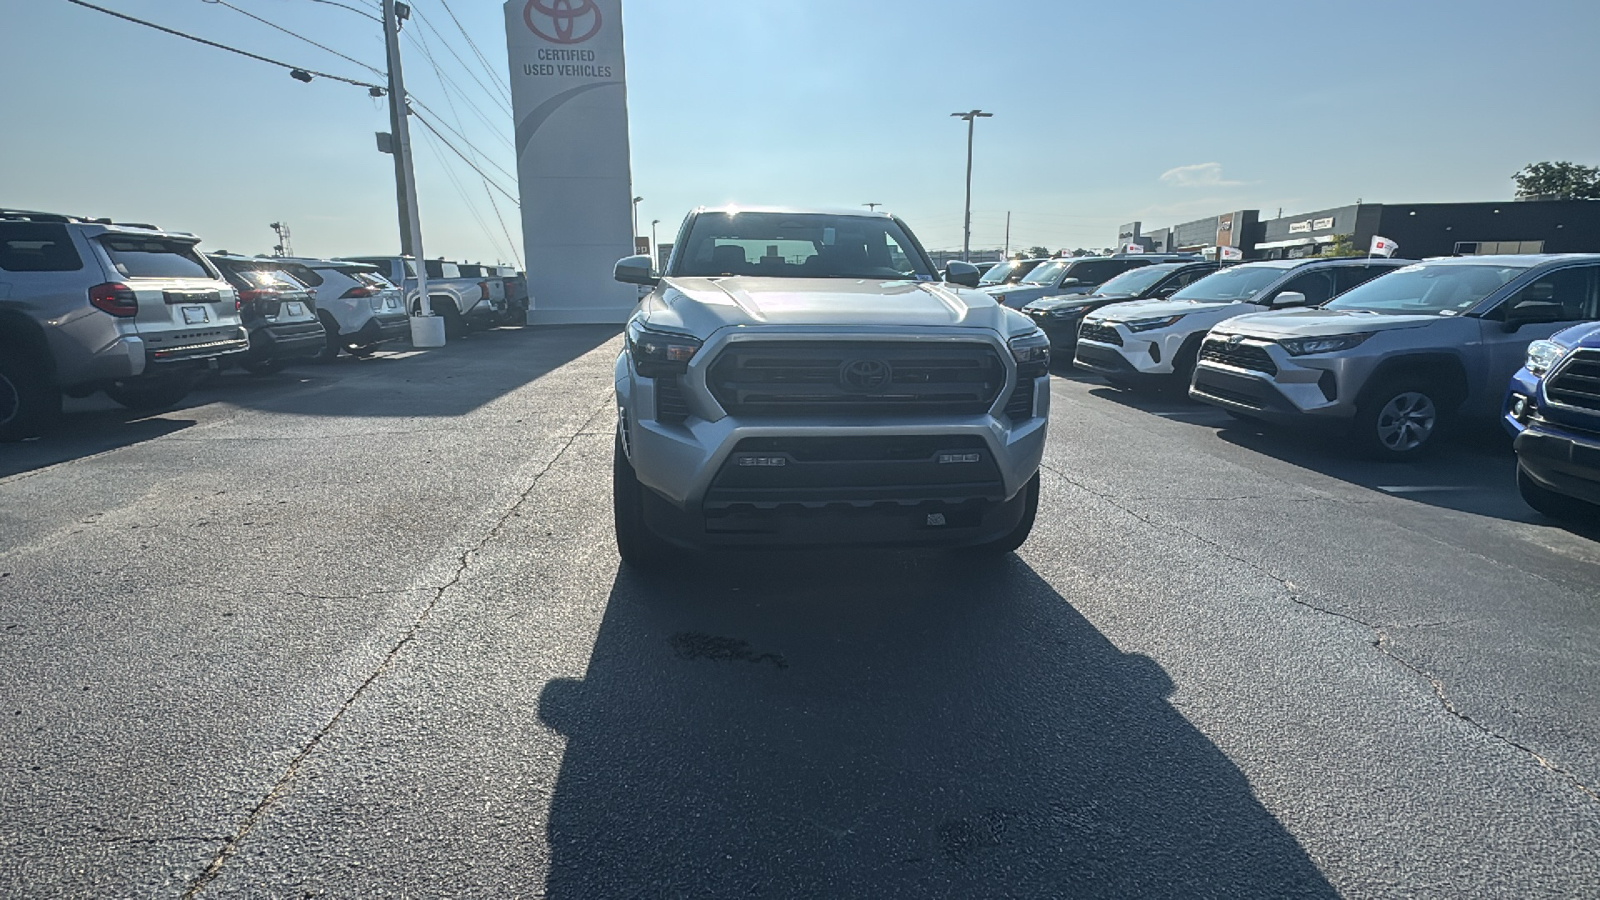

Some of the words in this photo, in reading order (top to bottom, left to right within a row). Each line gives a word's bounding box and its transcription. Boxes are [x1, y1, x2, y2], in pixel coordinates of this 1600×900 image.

[538, 49, 595, 61] CERTIFIED
[523, 64, 554, 76] USED
[557, 65, 612, 77] VEHICLES
